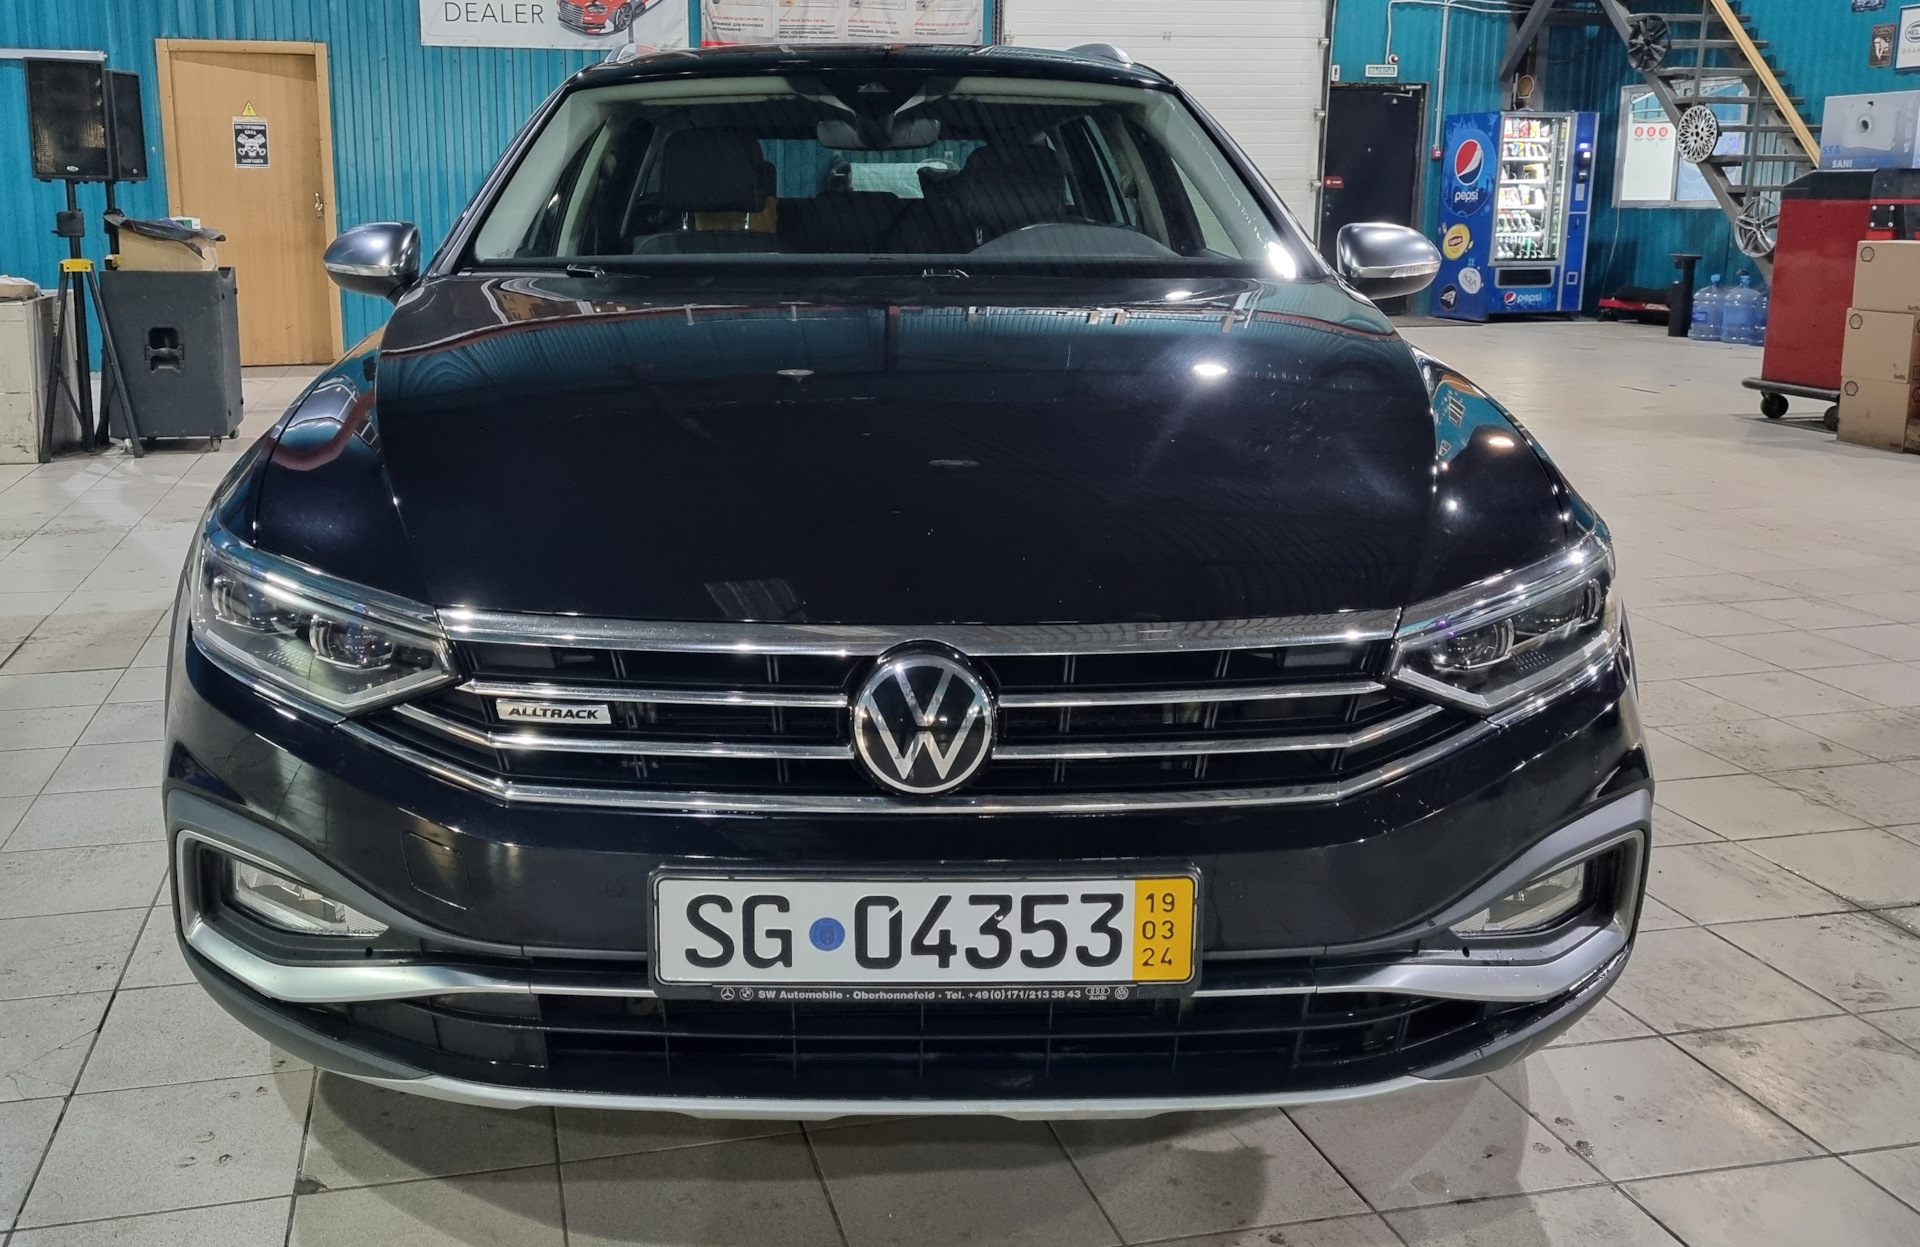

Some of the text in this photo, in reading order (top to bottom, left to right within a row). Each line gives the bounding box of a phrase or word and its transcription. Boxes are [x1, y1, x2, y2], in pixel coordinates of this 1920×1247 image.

[444, 2, 545, 24] DEALER
[1369, 66, 1395, 75] ВЫХОД
[1831, 159, 1853, 169] SANI
[1454, 189, 1479, 203] pepsi
[1516, 292, 1542, 304] pepsi
[507, 706, 600, 720] ALLTRACK
[1144, 892, 1177, 913] 19
[684, 892, 1125, 970] SG 04353
[1141, 920, 1176, 941] 03
[1141, 947, 1174, 968] 24
[757, 990, 777, 999] SW
[779, 990, 844, 999] Automobile
[852, 990, 936, 1000] Oberhonnefeld
[945, 990, 965, 999] Tel.
